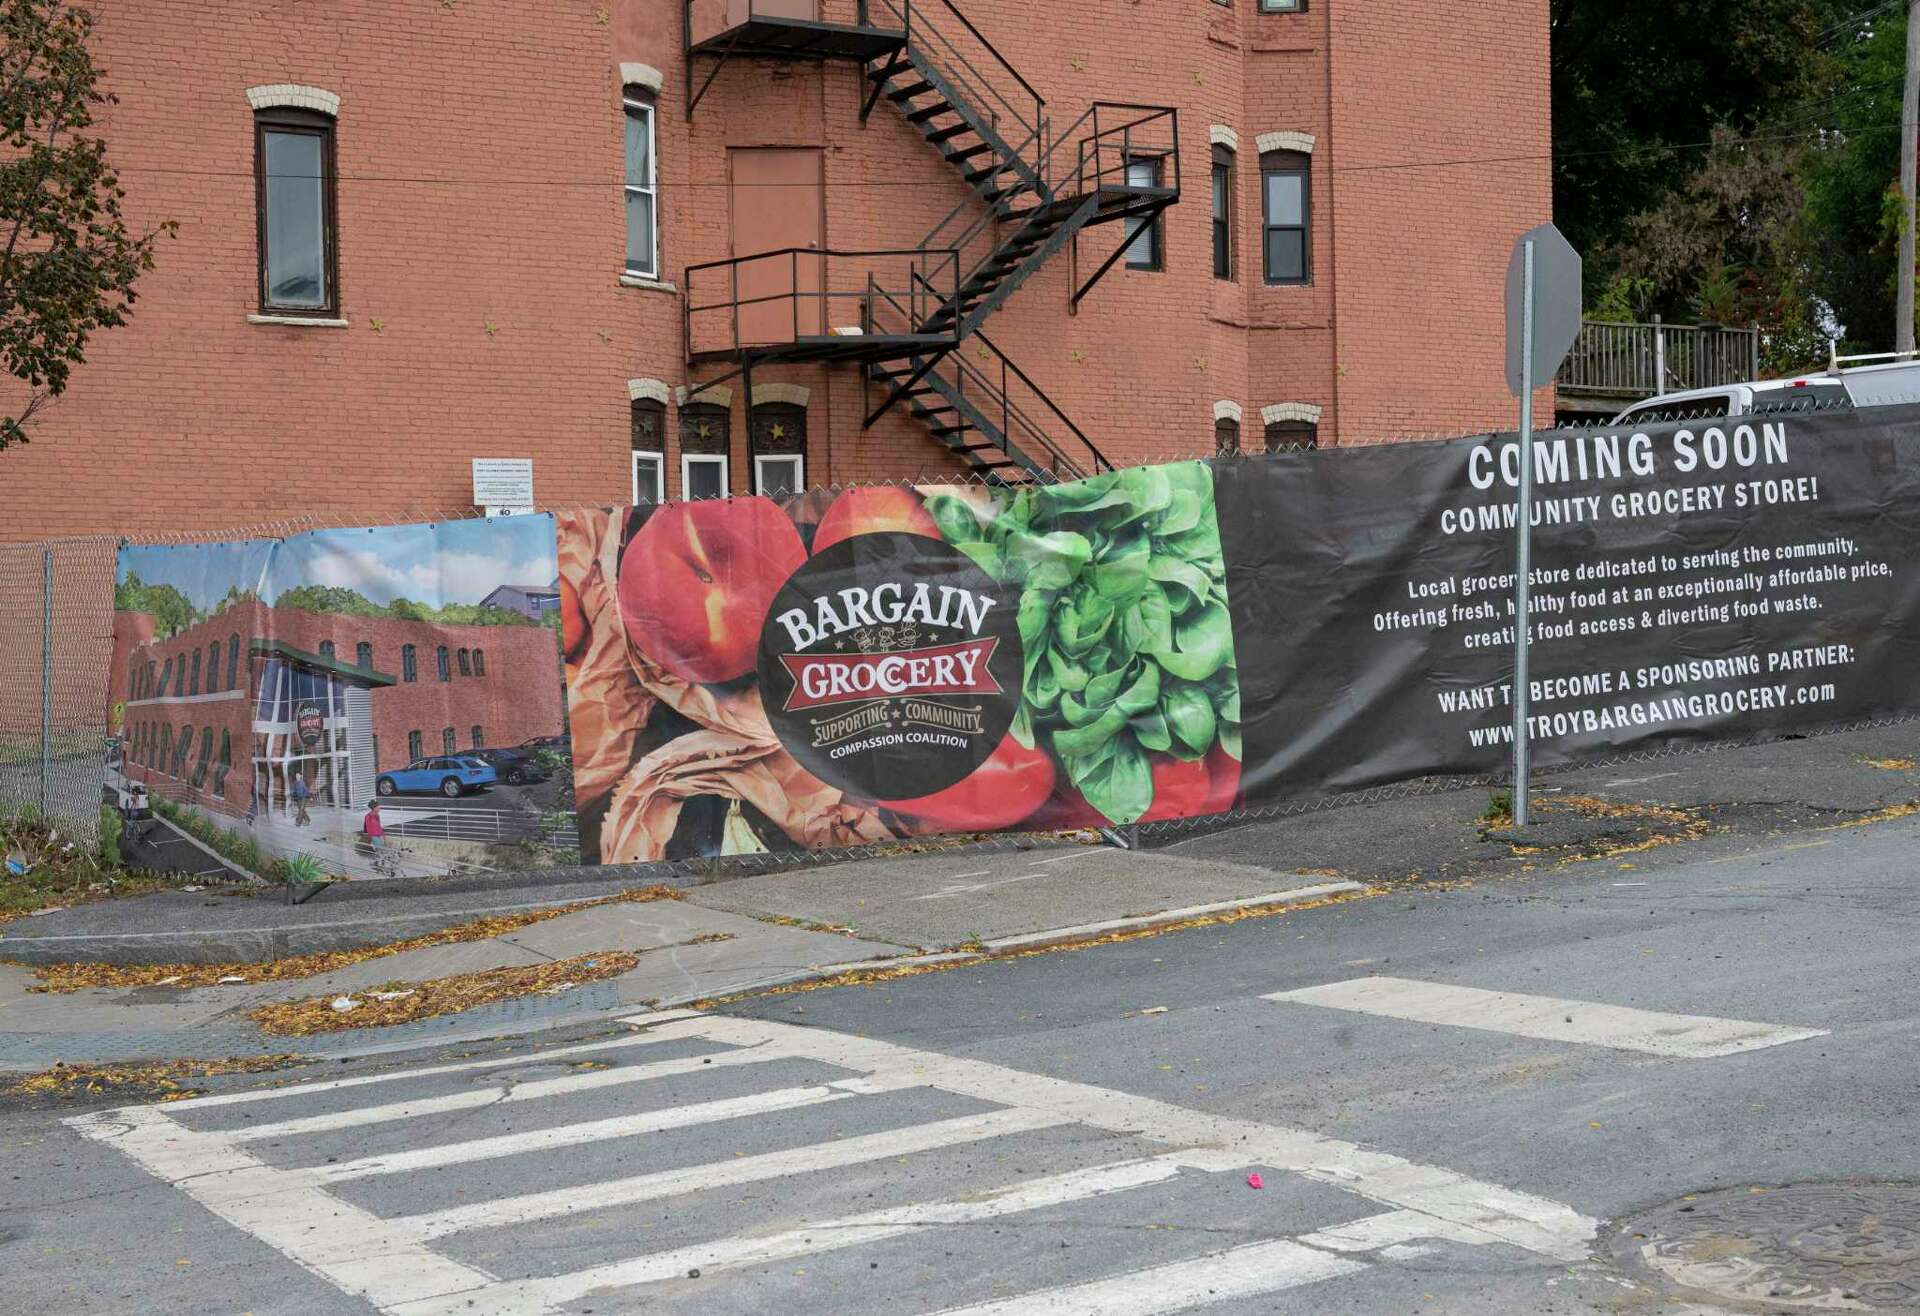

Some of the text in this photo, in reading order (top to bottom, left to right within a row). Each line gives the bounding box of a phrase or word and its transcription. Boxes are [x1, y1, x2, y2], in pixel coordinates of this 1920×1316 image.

[1468, 422, 1789, 490] COMING SOON
[1441, 476, 1818, 535] COMMUNITY GROCERY STORE!
[1373, 560, 1893, 632] Offering fresh, halthy food at an exceptionally affordable price,
[1408, 576, 1456, 599] Local
[1527, 567, 1570, 587] store
[1575, 555, 1657, 581] dedicated
[1660, 555, 1677, 572] to
[1682, 549, 1740, 570] serving
[1743, 545, 1770, 563] the
[1775, 537, 1859, 560] community.
[776, 582, 997, 652] BARGAIN
[1464, 593, 1823, 649] creatig food access & diverting food waste.
[801, 648, 982, 699] GROCERY
[1437, 686, 1495, 713] WANT
[1529, 672, 1613, 702] BECOME
[1618, 670, 1631, 691] A
[1636, 654, 1760, 689] SPONSORING
[1767, 644, 1855, 672] PARTNER:
[814, 702, 982, 744] SUPPORTING COMMUNITY
[829, 732, 968, 760] COMPASSION COALITION
[1468, 684, 1835, 748] wwwTROYBARGAINGROCERY.com
